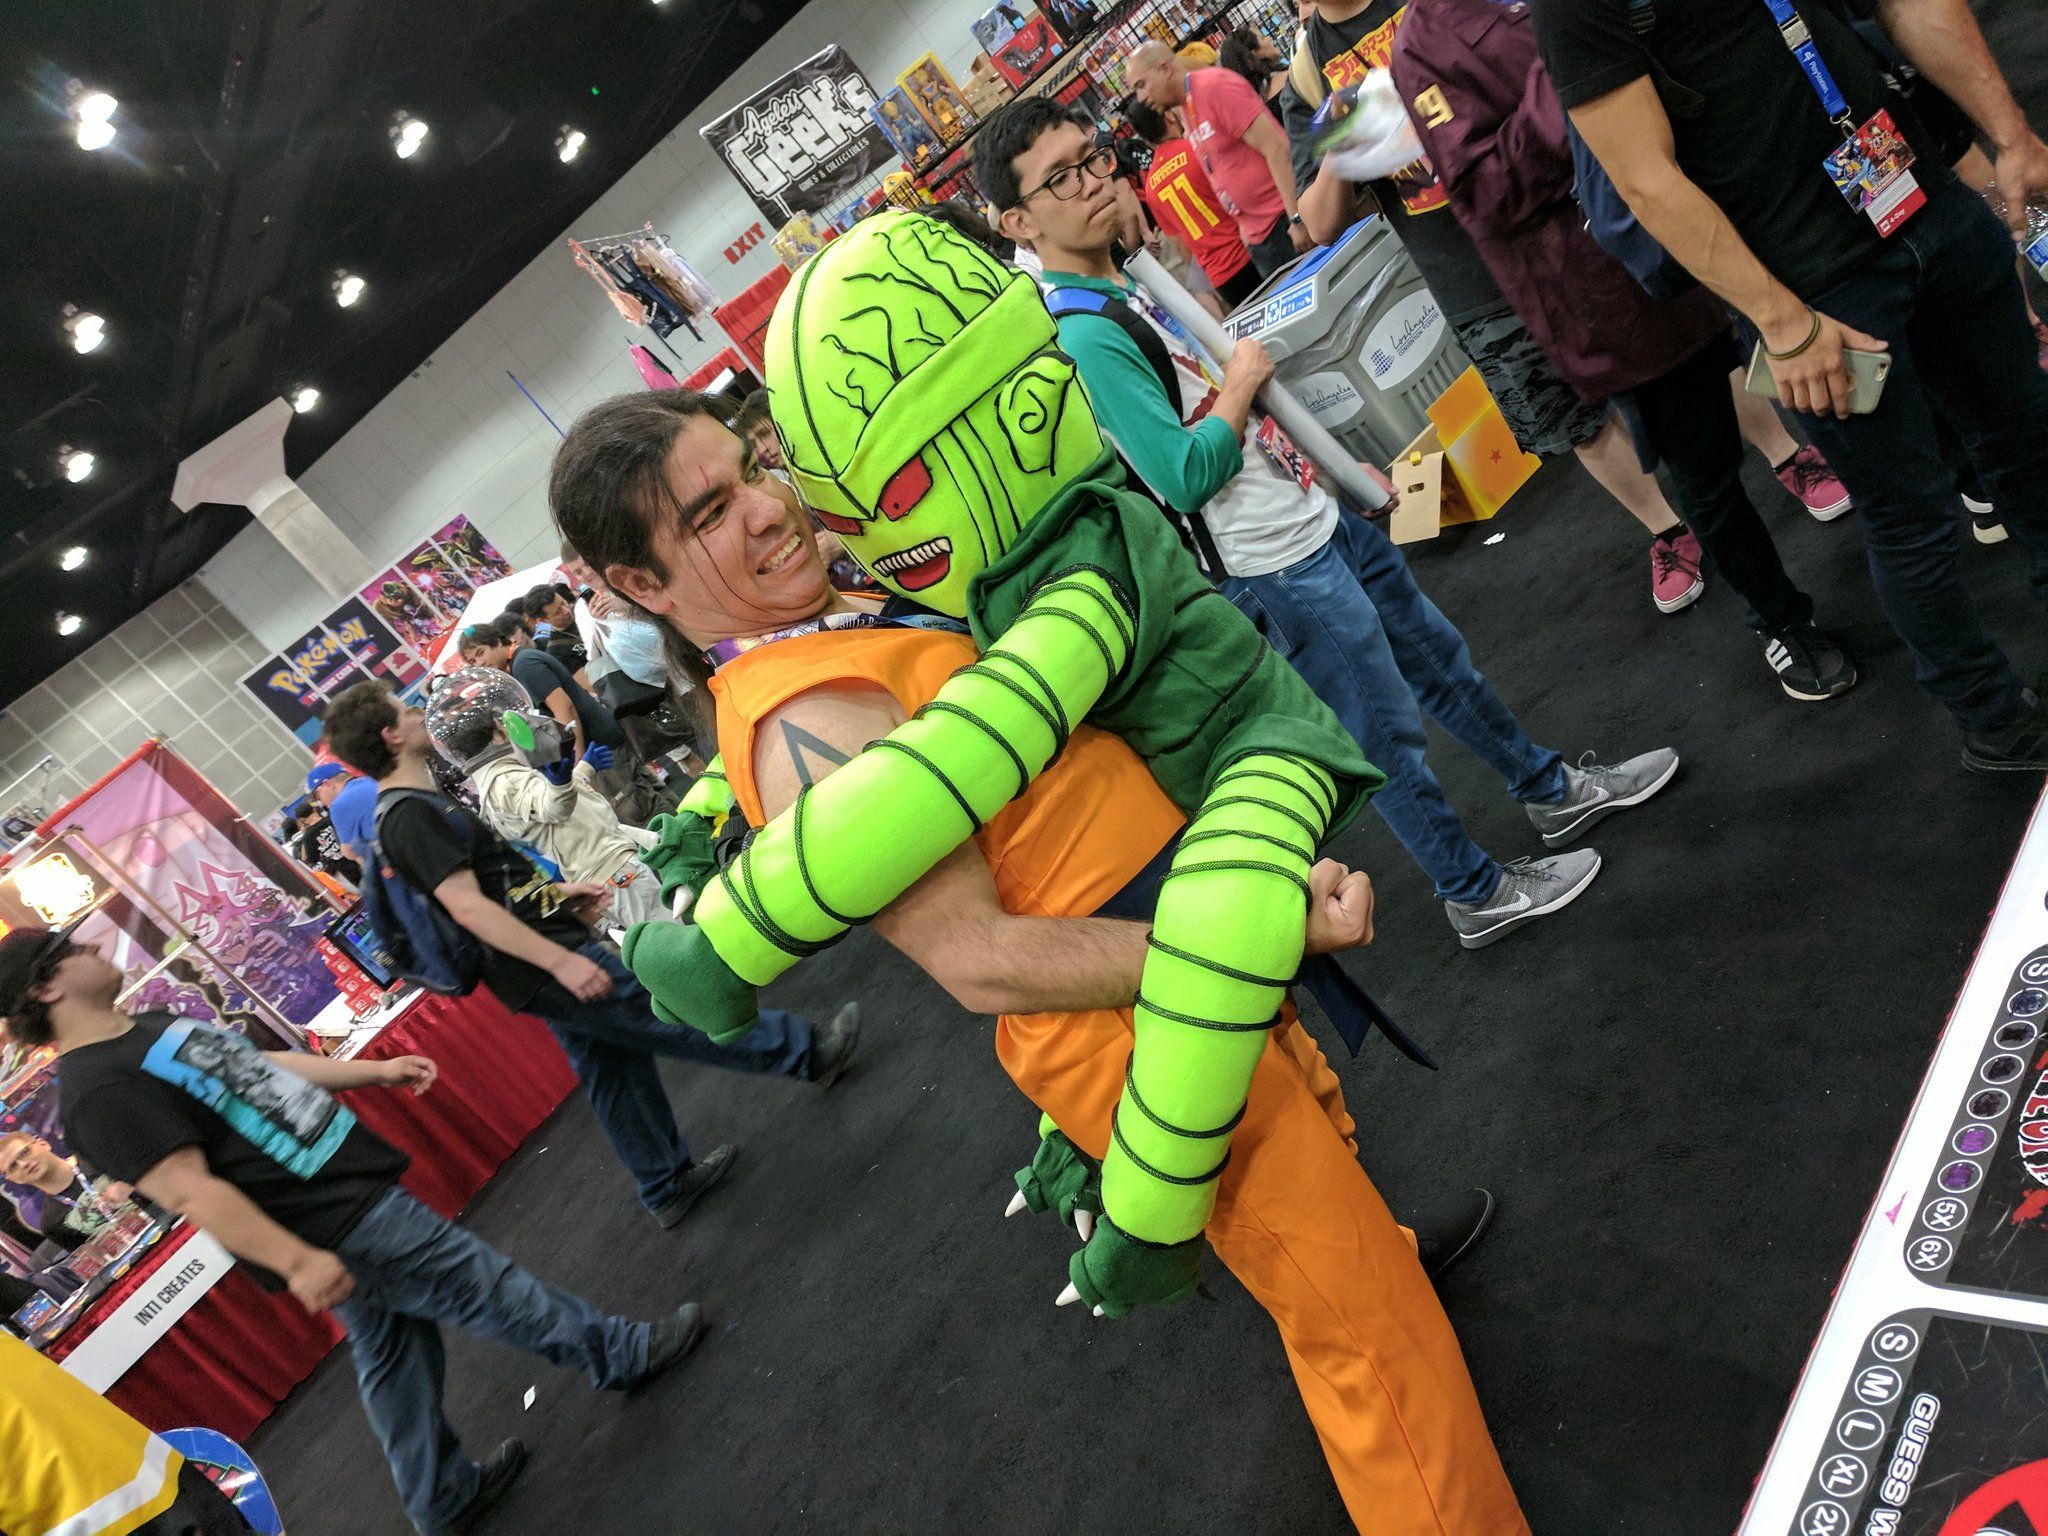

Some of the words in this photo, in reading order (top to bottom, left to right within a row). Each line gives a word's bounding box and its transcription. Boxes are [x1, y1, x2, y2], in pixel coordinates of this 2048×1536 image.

[1808, 61, 1829, 95] PlayStation
[743, 91, 804, 142] Ageless
[1413, 84, 1455, 129] 9
[1157, 173, 1220, 241] 11
[723, 222, 766, 266] EXIT
[1398, 330, 1424, 357] CONVENTION
[1425, 312, 1440, 329] CENTER
[1931, 1201, 1957, 1227] 5X
[1915, 1240, 1942, 1267] 6X
[134, 1300, 163, 1327] INTI
[156, 1258, 206, 1305] CREATES
[1880, 1332, 1908, 1352] S
[1861, 1372, 1894, 1399] M
[1844, 1419, 1876, 1437] L
[1879, 1393, 1941, 1507] GUESS
[1827, 1459, 1859, 1490] XL
